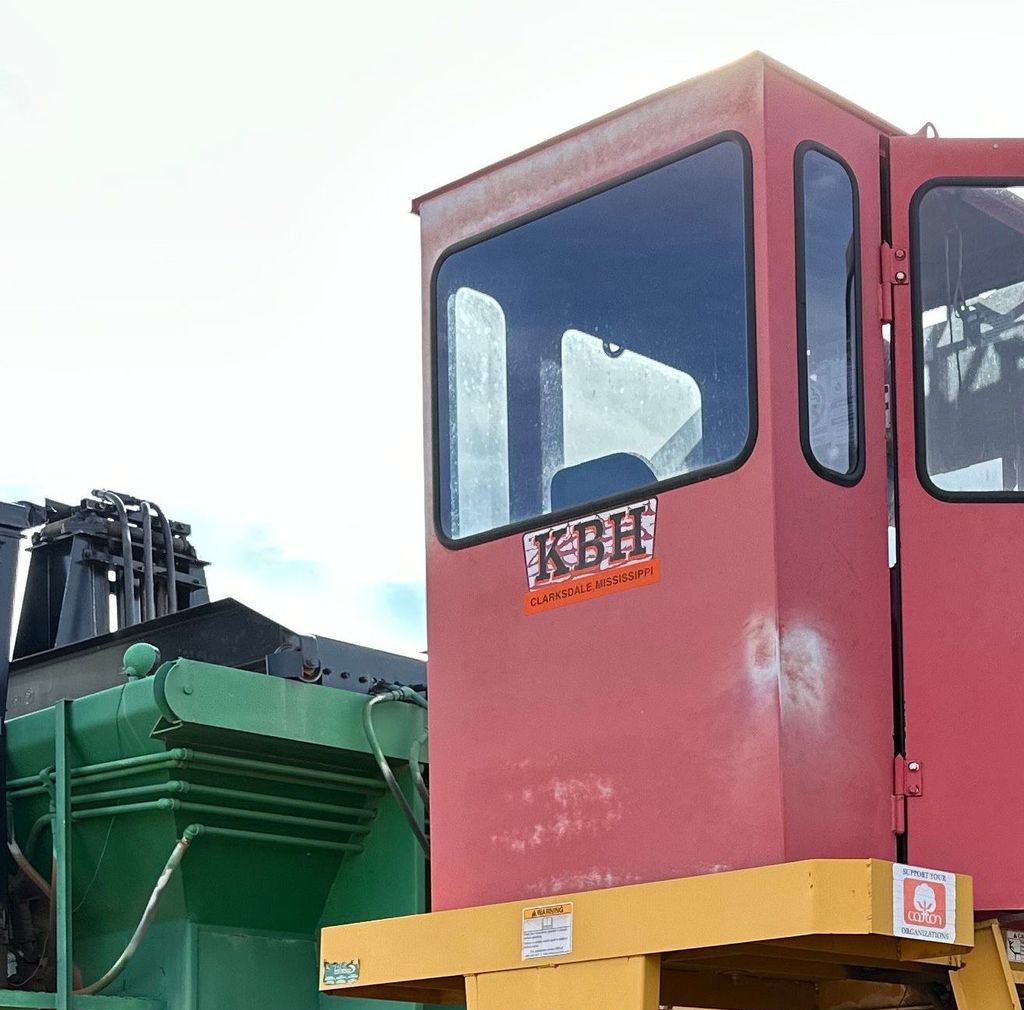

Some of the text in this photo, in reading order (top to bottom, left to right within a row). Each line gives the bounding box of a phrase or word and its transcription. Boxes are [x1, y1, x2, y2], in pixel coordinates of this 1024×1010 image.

[534, 505, 647, 581] KBH
[902, 868, 947, 882] SUPPORT YOUR
[536, 904, 564, 917] WARNING
[907, 910, 943, 926] cotton
[901, 926, 950, 940] ORGANIZATIONS
